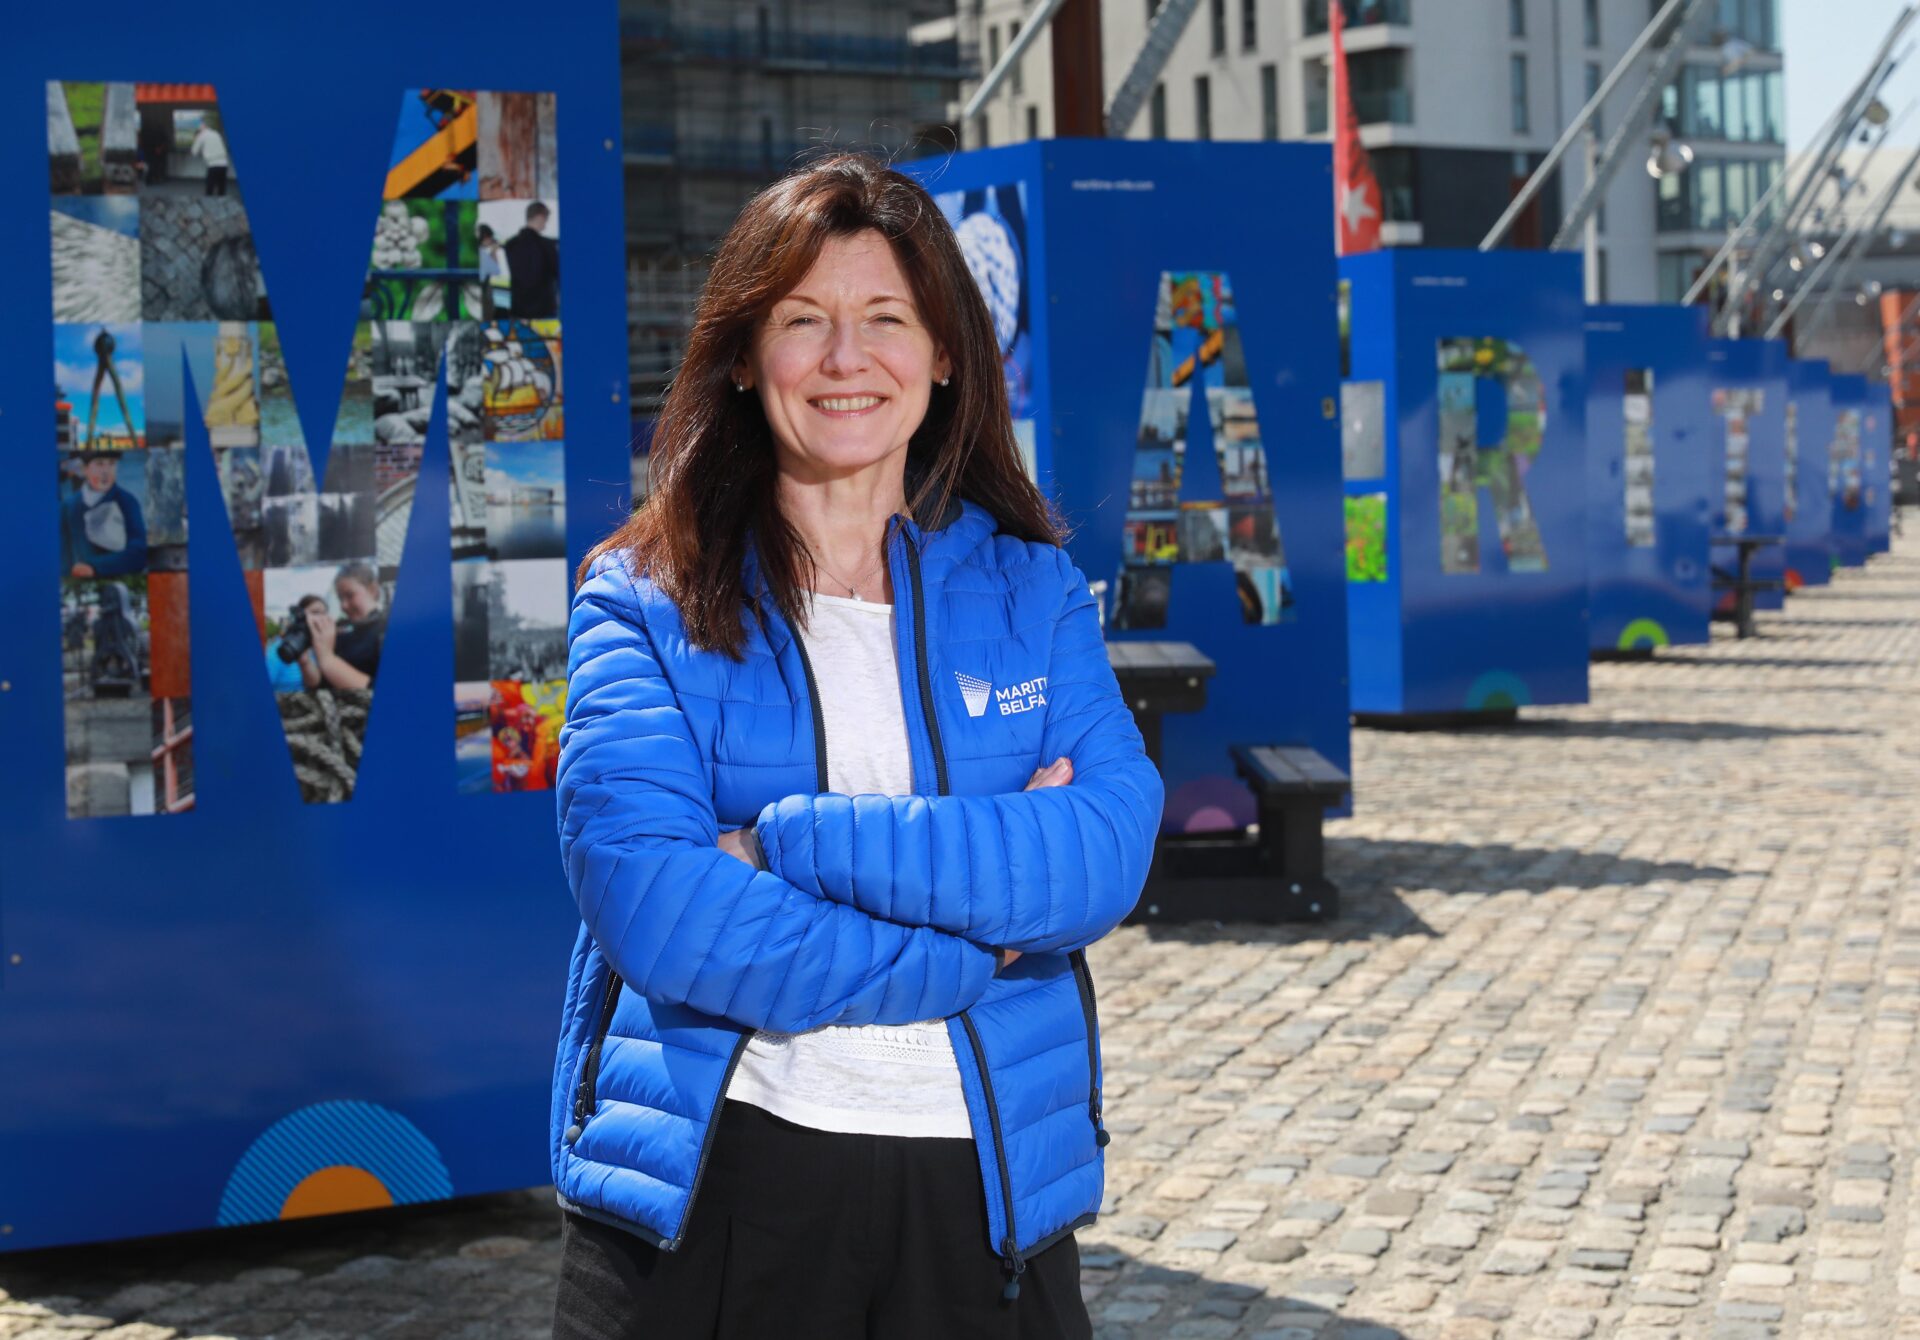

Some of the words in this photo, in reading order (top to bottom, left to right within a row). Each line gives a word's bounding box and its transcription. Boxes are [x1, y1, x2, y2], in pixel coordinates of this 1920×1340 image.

[47, 81, 568, 820] M
[1111, 271, 1296, 629] A
[1437, 337, 1549, 573] R
